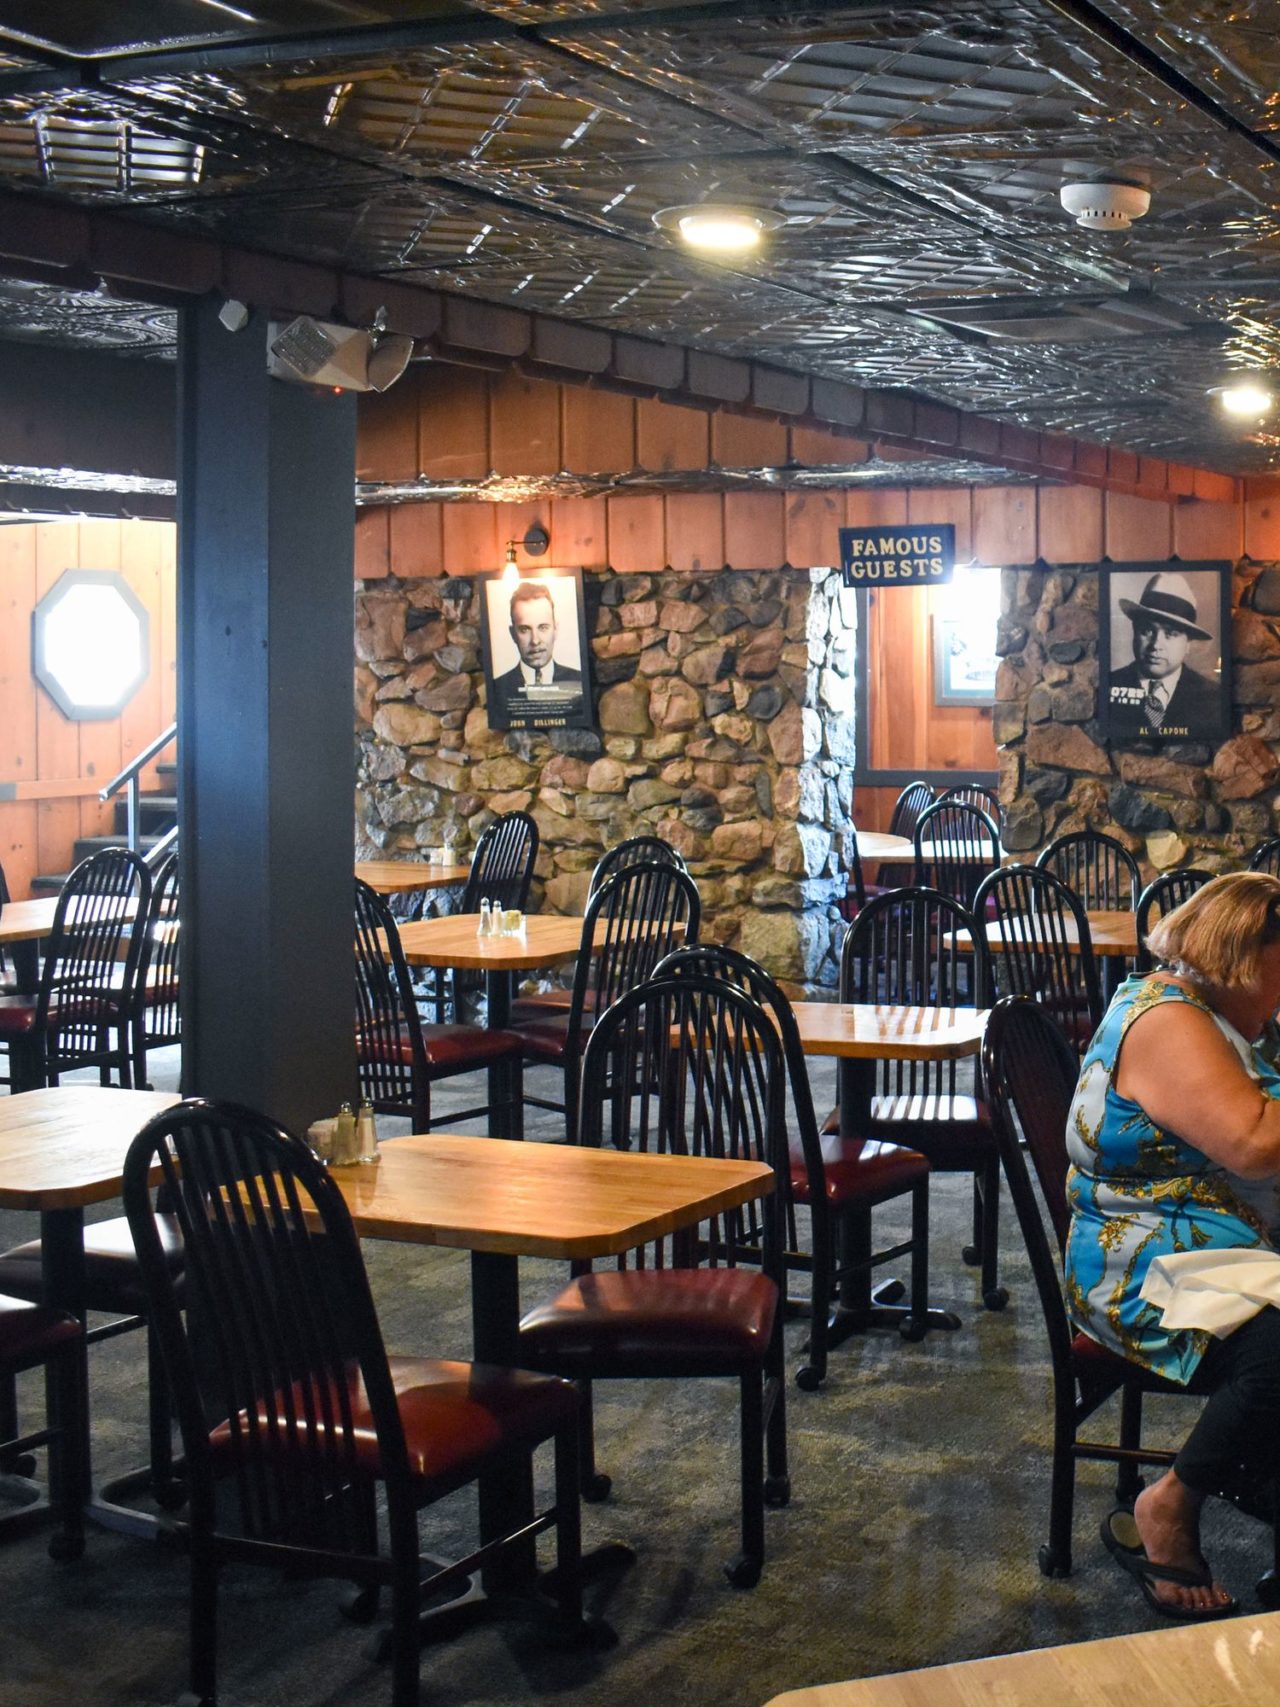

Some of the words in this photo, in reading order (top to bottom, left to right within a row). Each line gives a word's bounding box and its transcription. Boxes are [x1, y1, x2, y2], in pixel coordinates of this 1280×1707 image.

[851, 536, 942, 557] FAMOUS
[850, 557, 944, 579] GUESTS
[1139, 727, 1149, 736] AL
[1158, 727, 1189, 736] CAPONE
